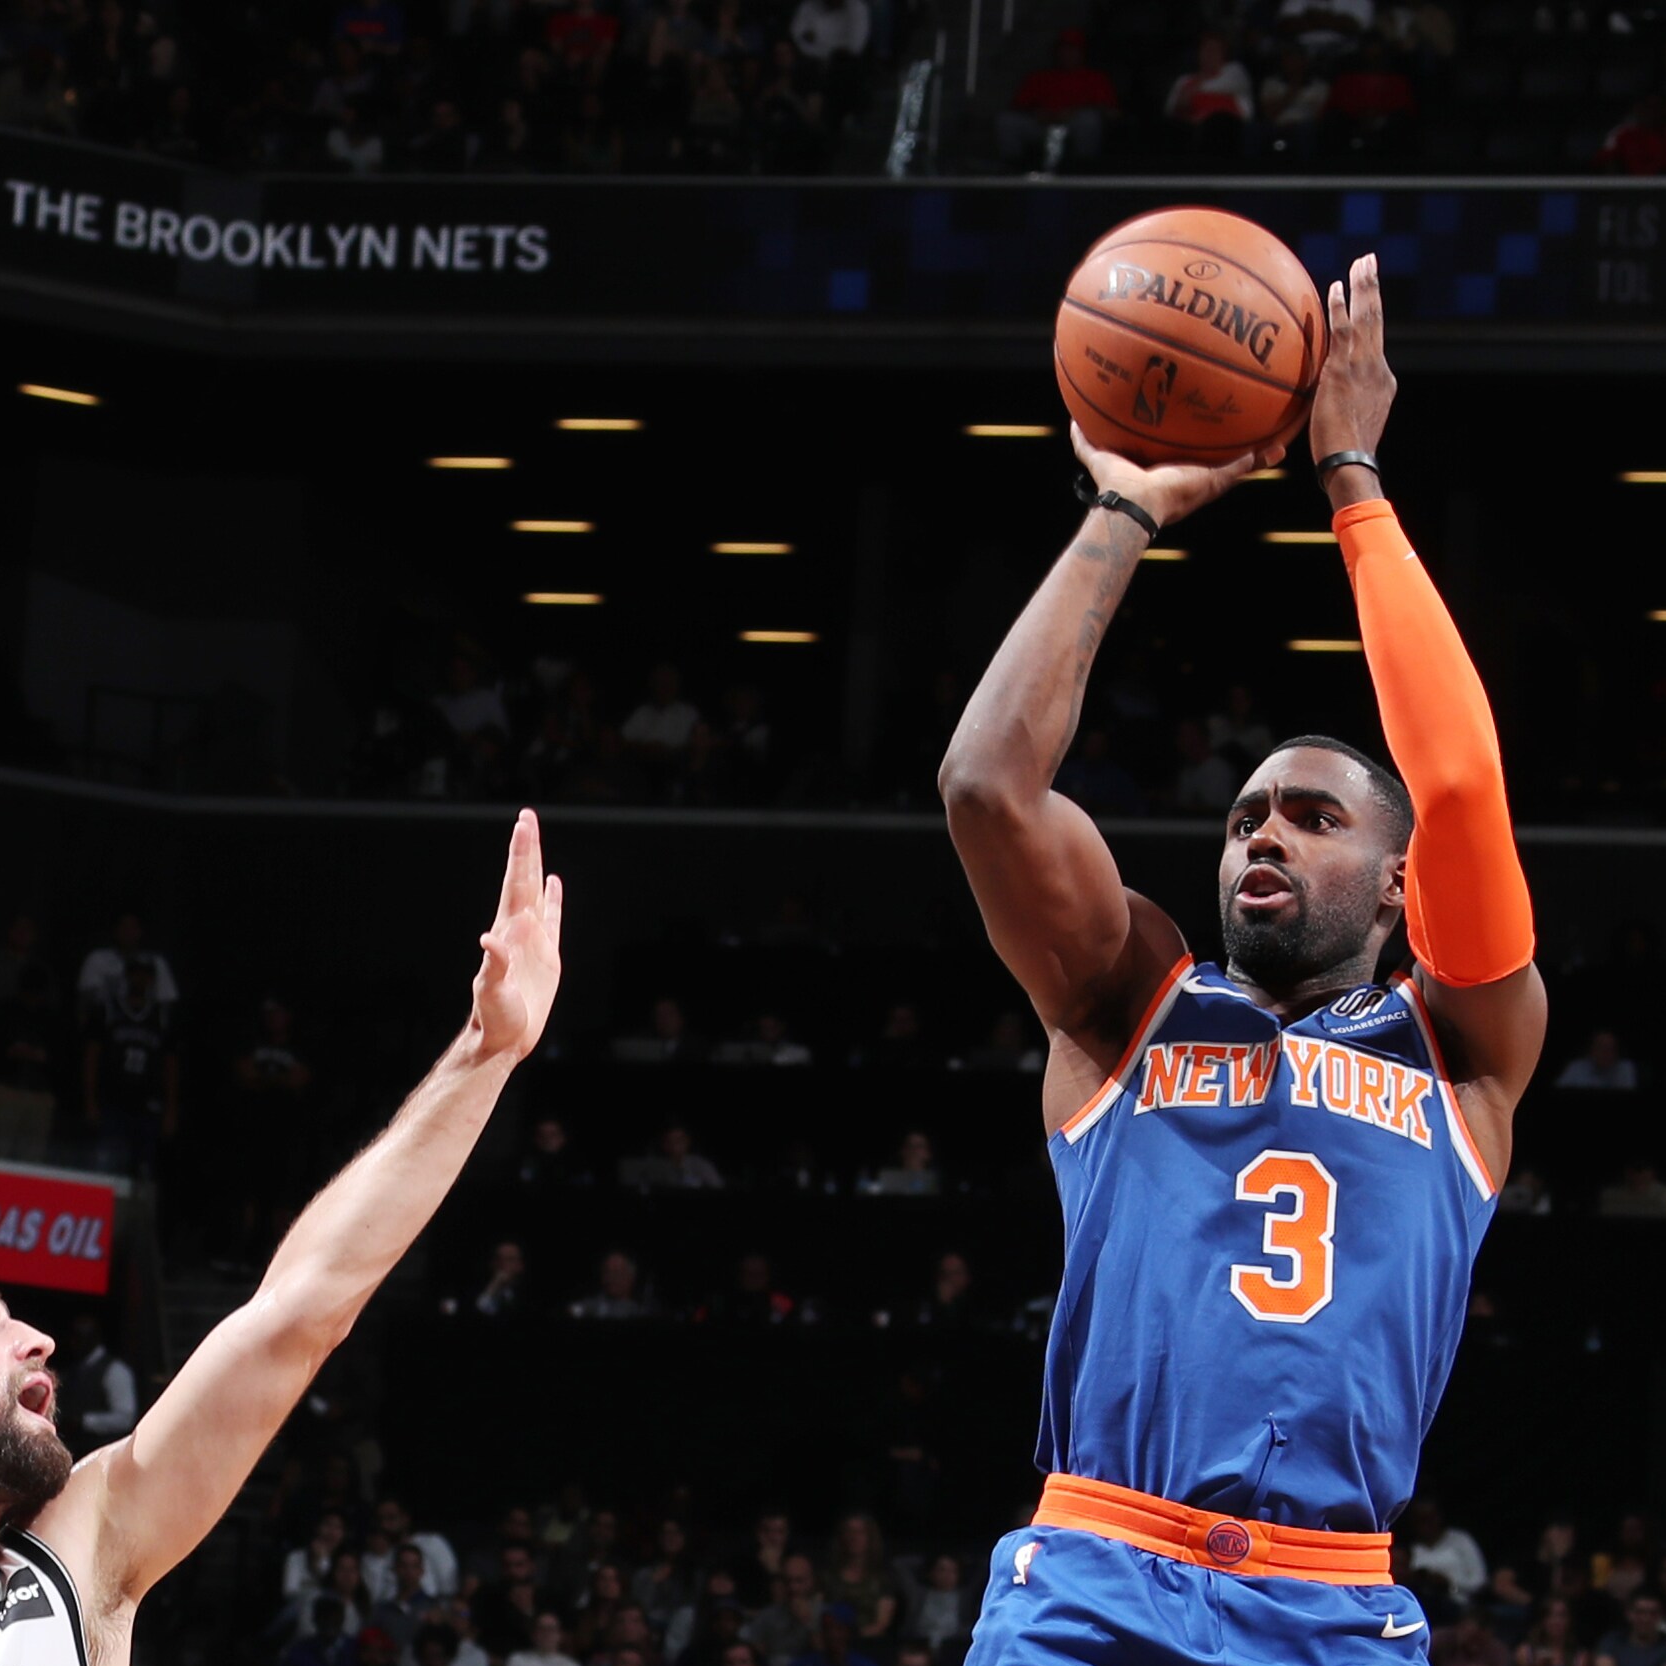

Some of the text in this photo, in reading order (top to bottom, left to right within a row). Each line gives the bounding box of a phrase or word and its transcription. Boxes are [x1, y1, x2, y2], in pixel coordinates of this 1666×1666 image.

[6, 179, 102, 242] THE
[114, 202, 400, 270] BROOKLYN
[411, 225, 549, 271] NETS
[1098, 262, 1281, 366] SPALDING
[1330, 1009, 1410, 1034] SQUARESPACE
[1133, 1031, 1433, 1149] NEW YORK
[47, 1211, 104, 1260] OIL
[1231, 1150, 1337, 1323] 3
